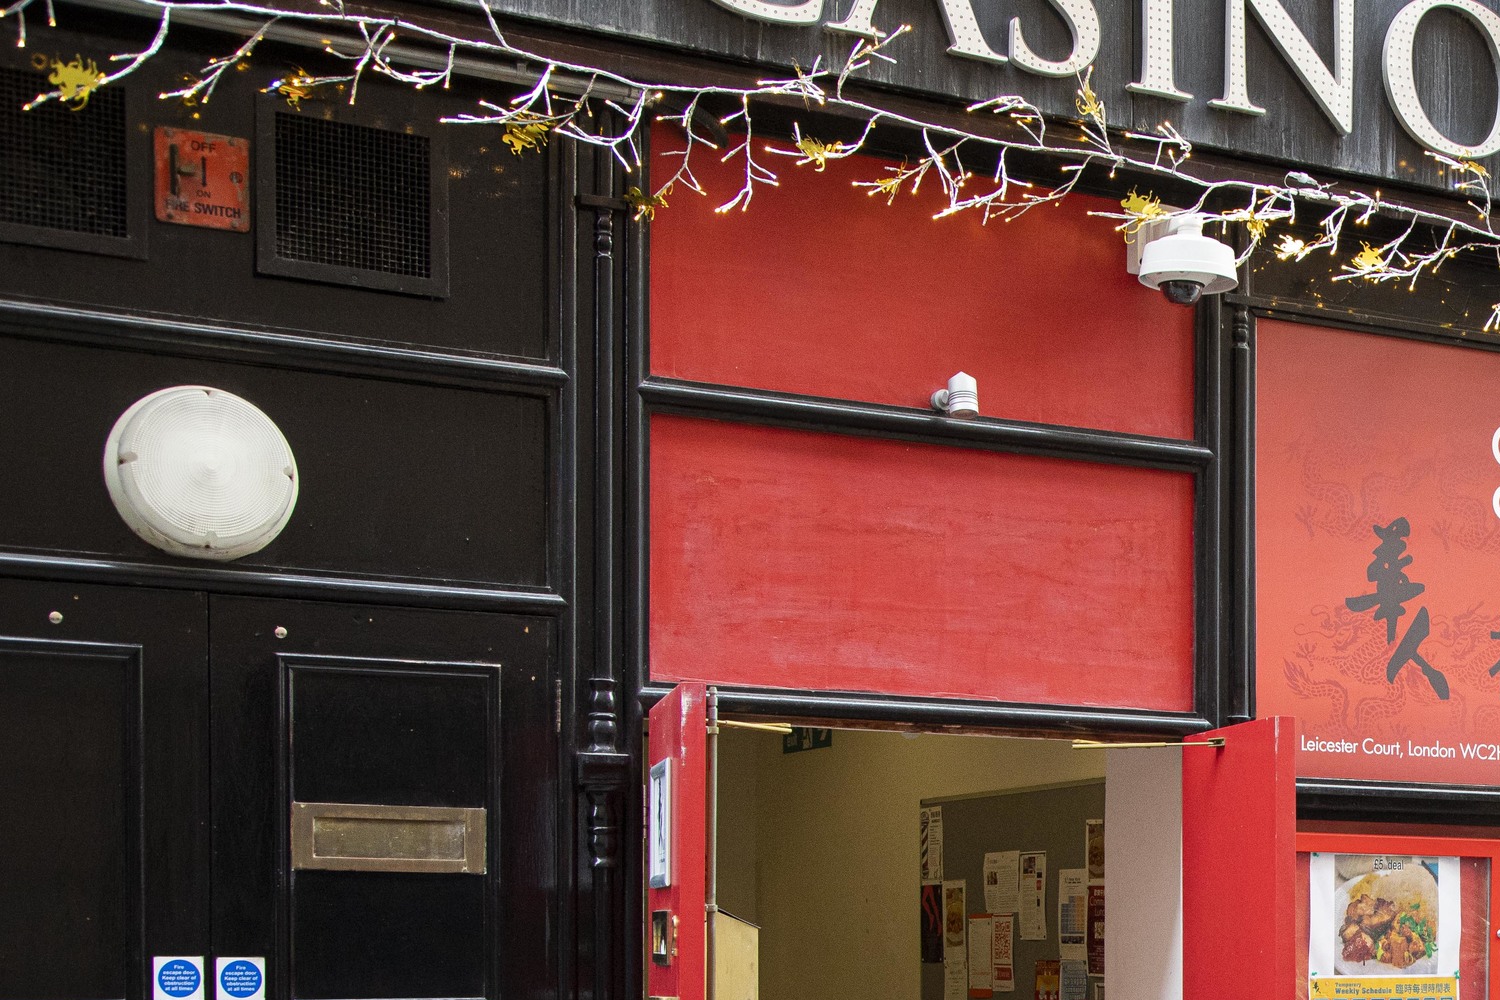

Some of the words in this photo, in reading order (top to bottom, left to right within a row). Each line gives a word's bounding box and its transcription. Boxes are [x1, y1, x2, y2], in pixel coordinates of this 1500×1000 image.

[191, 140, 216, 152] OFF
[196, 190, 211, 198] ON
[194, 202, 241, 218] SWITCH
[1301, 735, 1358, 753] Leicester
[1362, 738, 1404, 759] Court,
[1408, 740, 1456, 759] London
[1374, 858, 1384, 870] £5
[1388, 859, 1404, 870] deal
